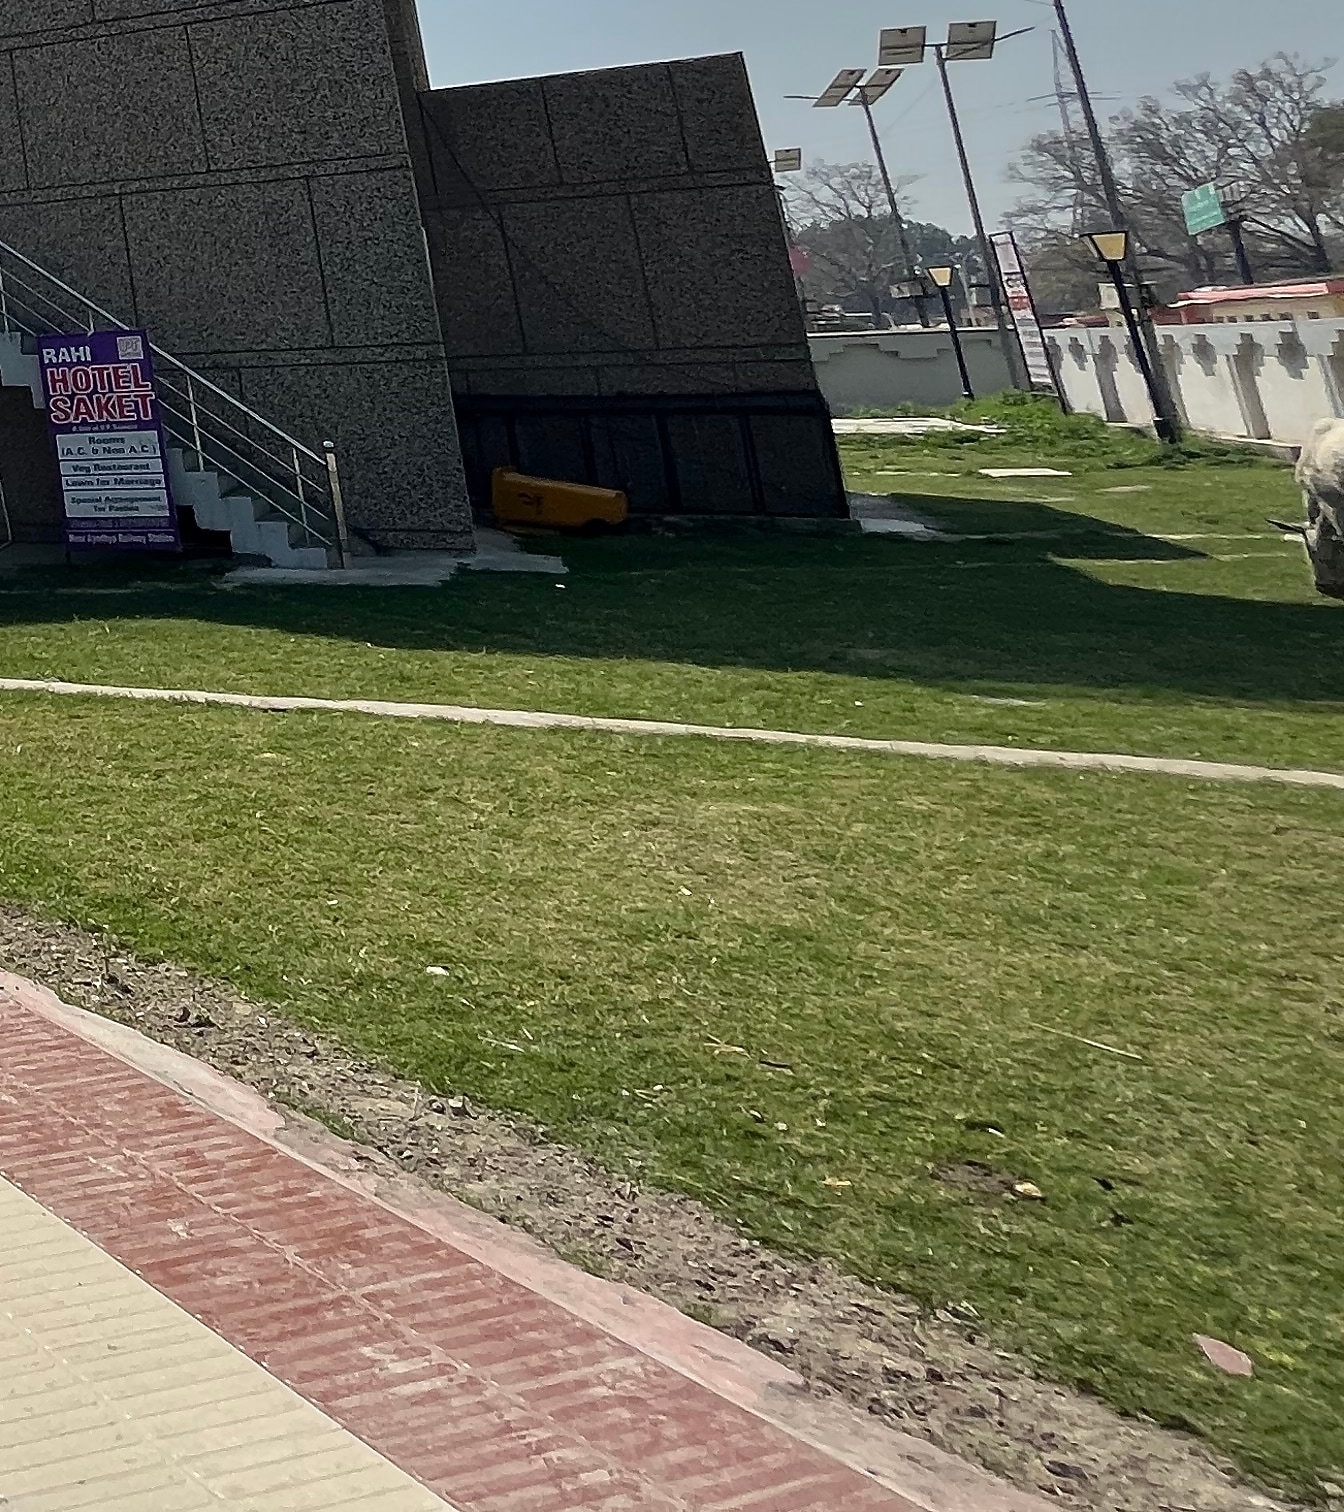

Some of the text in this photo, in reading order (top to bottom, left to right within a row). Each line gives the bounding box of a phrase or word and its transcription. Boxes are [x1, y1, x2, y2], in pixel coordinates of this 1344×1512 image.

[42, 345, 92, 364] RAHI
[47, 363, 152, 395] HOTEL
[49, 392, 156, 424] SAKET
[71, 464, 91, 473] Veg
